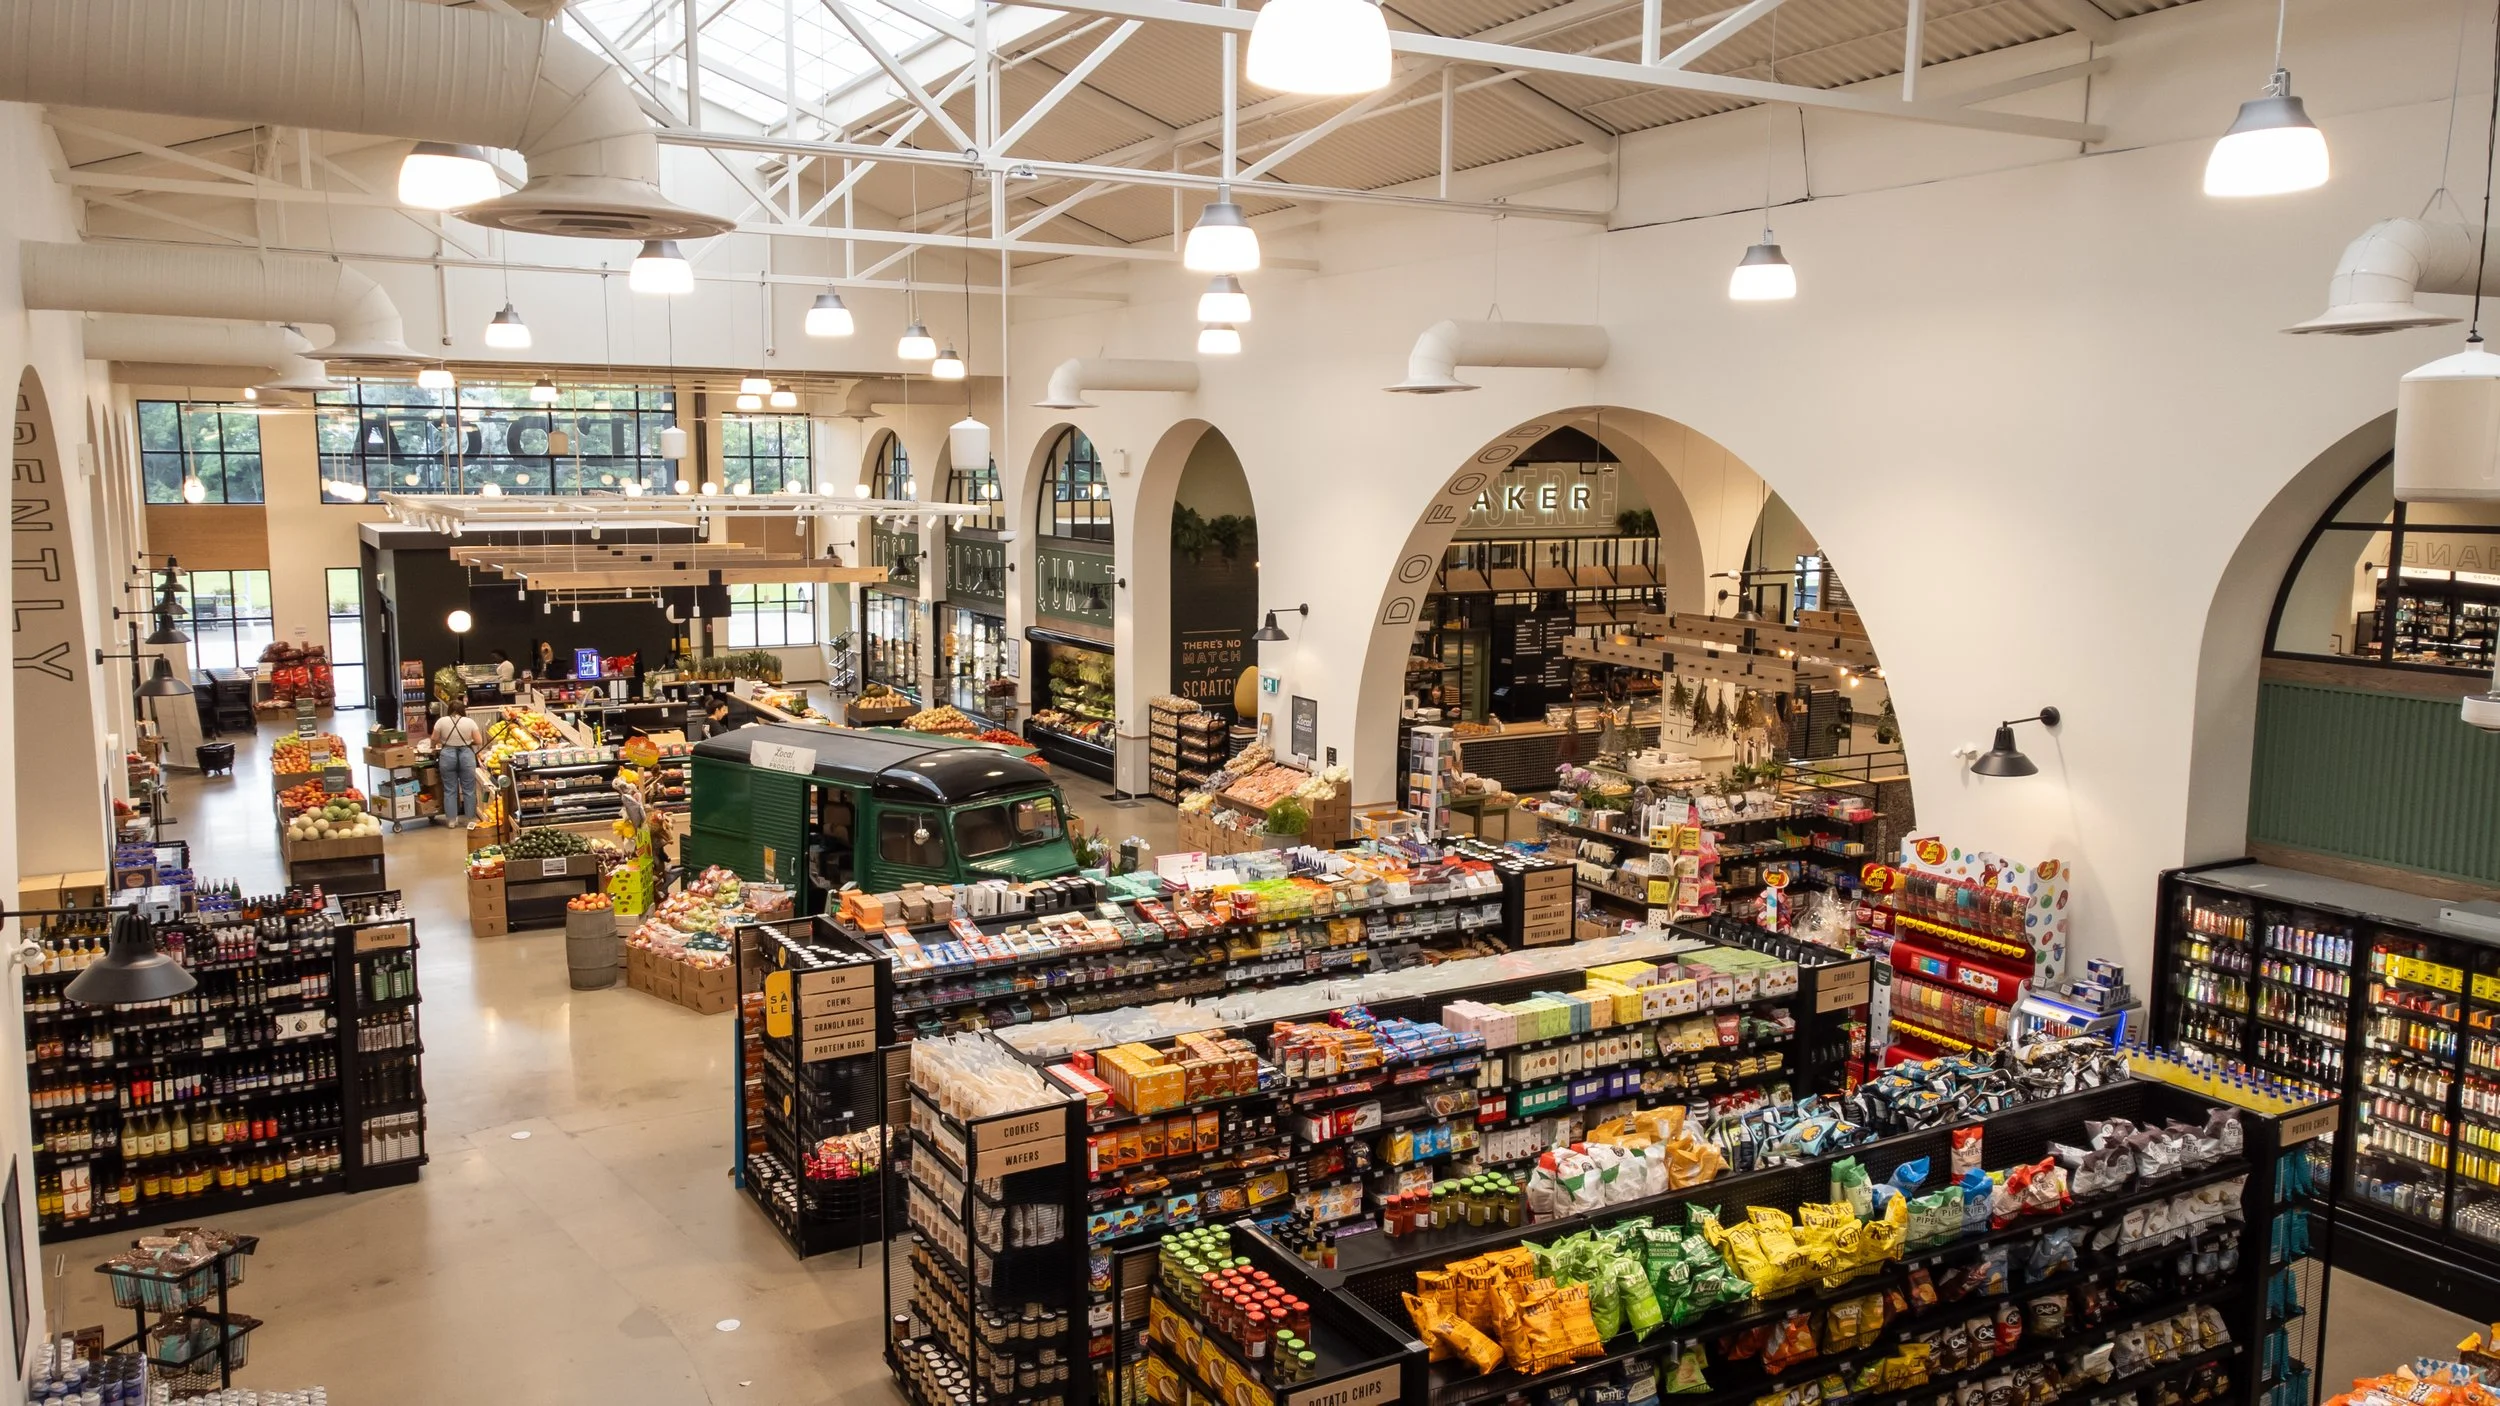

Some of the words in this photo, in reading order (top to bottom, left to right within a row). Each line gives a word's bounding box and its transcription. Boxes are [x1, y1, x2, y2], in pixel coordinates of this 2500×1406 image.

[1472, 486, 1591, 510] AKER
[1382, 554, 1433, 625] DO
[1425, 424, 1550, 524] FOOD
[1182, 640, 1223, 650] THERE'S
[1226, 639, 1241, 648] NO
[1183, 650, 1241, 664] MATCH
[1206, 665, 1218, 676] for
[1183, 679, 1236, 698] SCRATC
[774, 746, 795, 759] Local
[769, 762, 796, 772] PRODUCE
[831, 975, 846, 985] GUM
[826, 997, 851, 1008] CHEWS
[814, 1020, 845, 1033] GRANOLA
[847, 1017, 865, 1027] BARS
[814, 1042, 845, 1055] PROTEIN
[847, 1039, 865, 1050] BARS
[1003, 1121, 1040, 1138] COOKIES
[1005, 1150, 1039, 1166] WAFERS
[1309, 1390, 1348, 1406] POTATO
[1352, 1380, 1382, 1401] CHIPS
